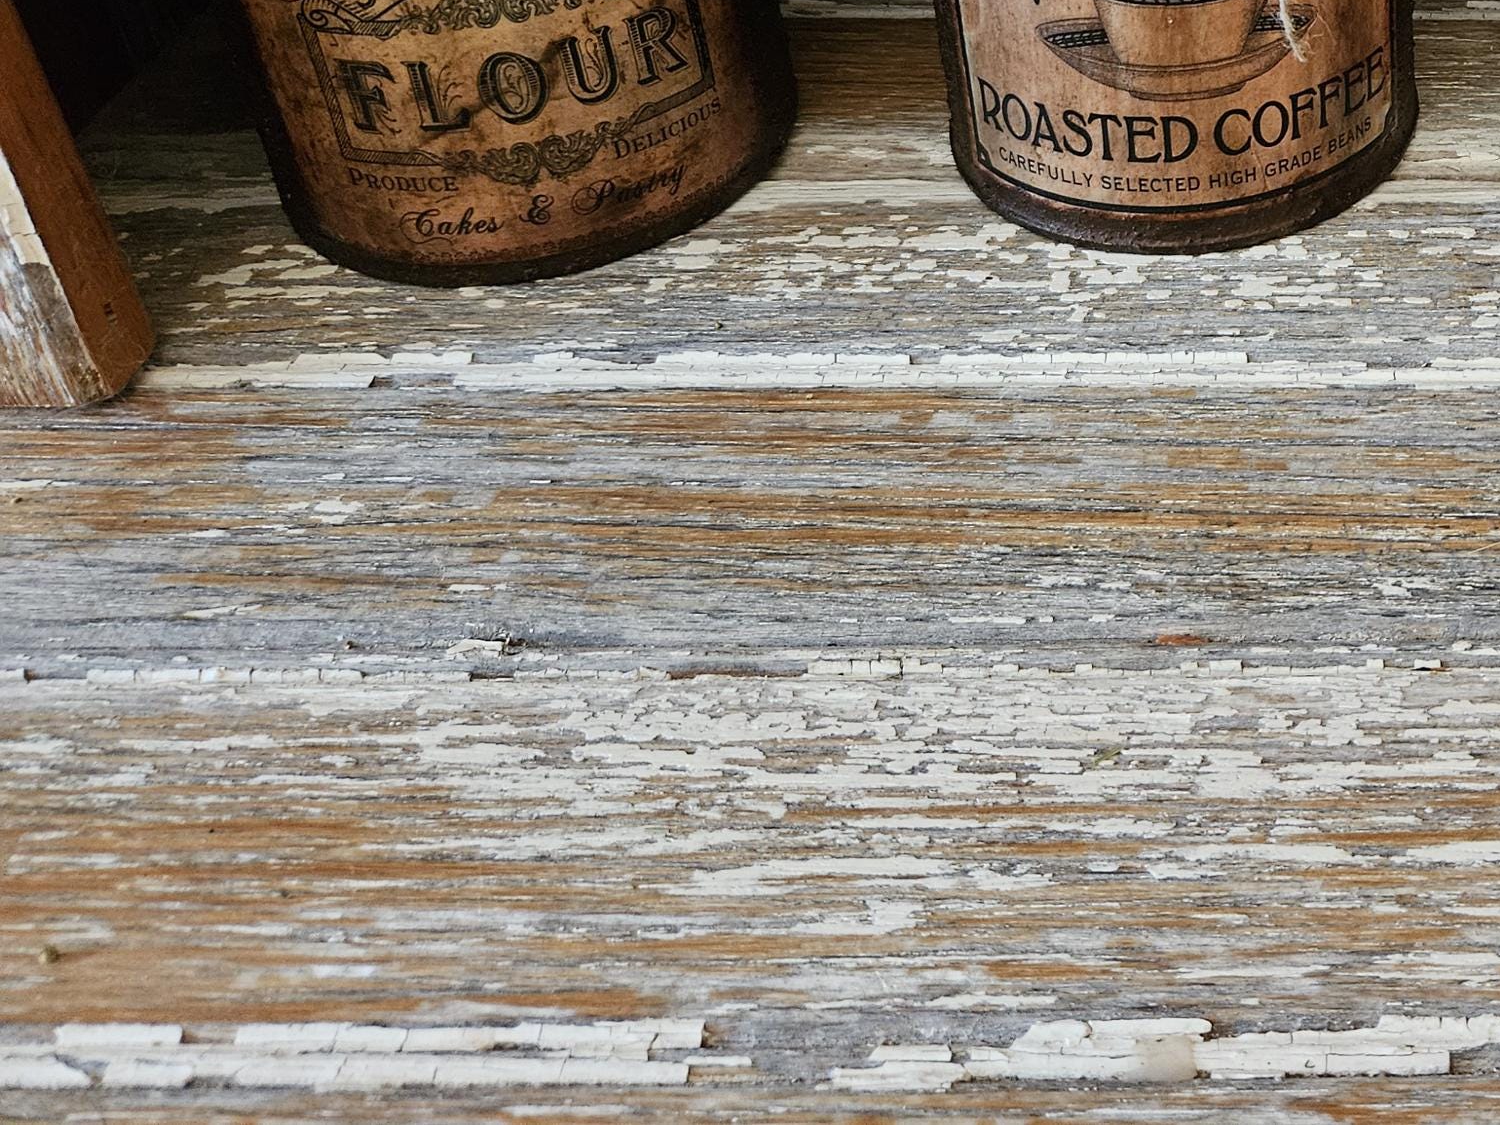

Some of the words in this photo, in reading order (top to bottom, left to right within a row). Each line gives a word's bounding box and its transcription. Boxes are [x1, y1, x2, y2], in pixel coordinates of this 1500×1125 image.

[335, 5, 690, 137] FLOUR
[977, 75, 1199, 163] ROASTED
[1213, 45, 1389, 156] COFFEE
[350, 168, 460, 193] PRODUCE
[614, 96, 723, 160] DELICIOUS
[999, 146, 1093, 189] CAREFULLY
[1100, 174, 1201, 193] SELECTED
[1208, 169, 1257, 190] HIGH
[1263, 146, 1322, 180] GRADE
[1327, 116, 1372, 157] BEANS
[400, 208, 505, 245] Cakes
[519, 193, 556, 225] &
[571, 163, 688, 216] Pastry
